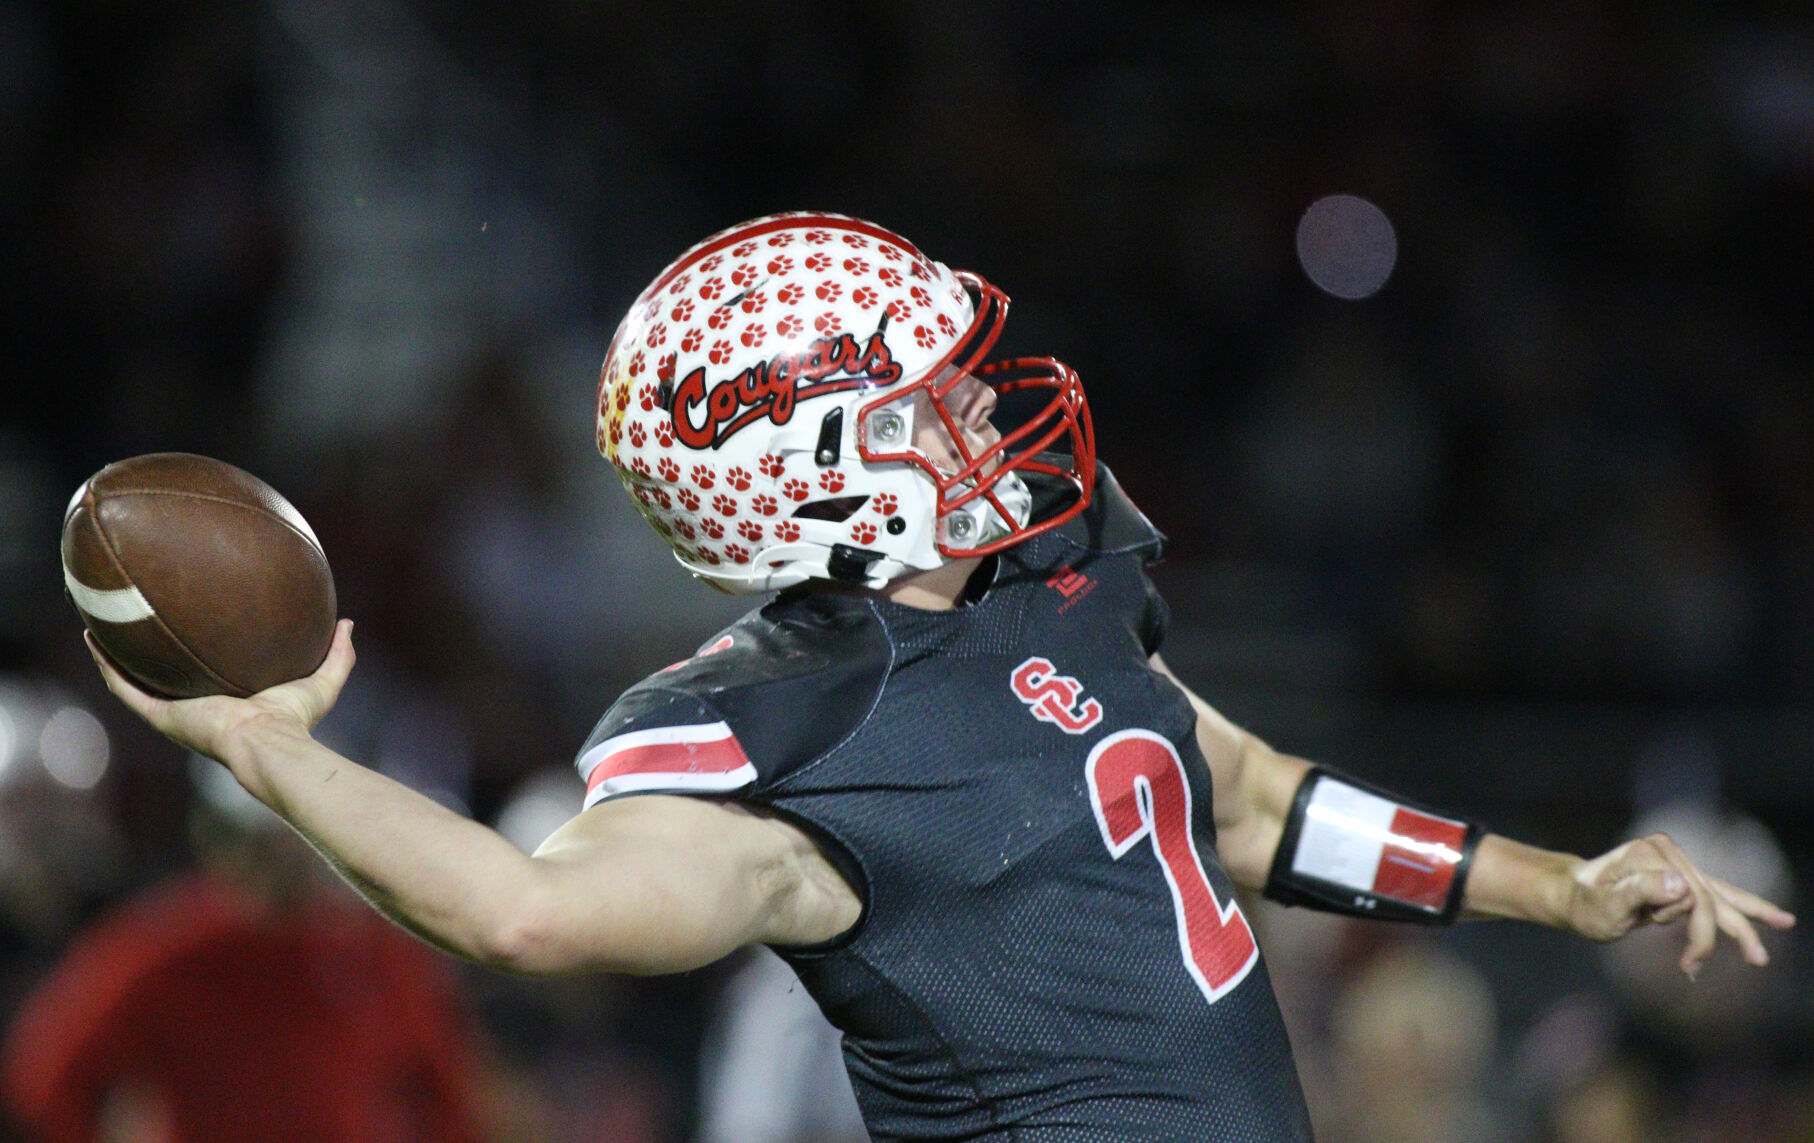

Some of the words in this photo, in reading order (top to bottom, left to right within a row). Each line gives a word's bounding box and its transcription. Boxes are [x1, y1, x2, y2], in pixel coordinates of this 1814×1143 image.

[671, 333, 903, 450] Cougars
[1010, 656, 1103, 735] SC
[1085, 728, 1259, 1005] 2
